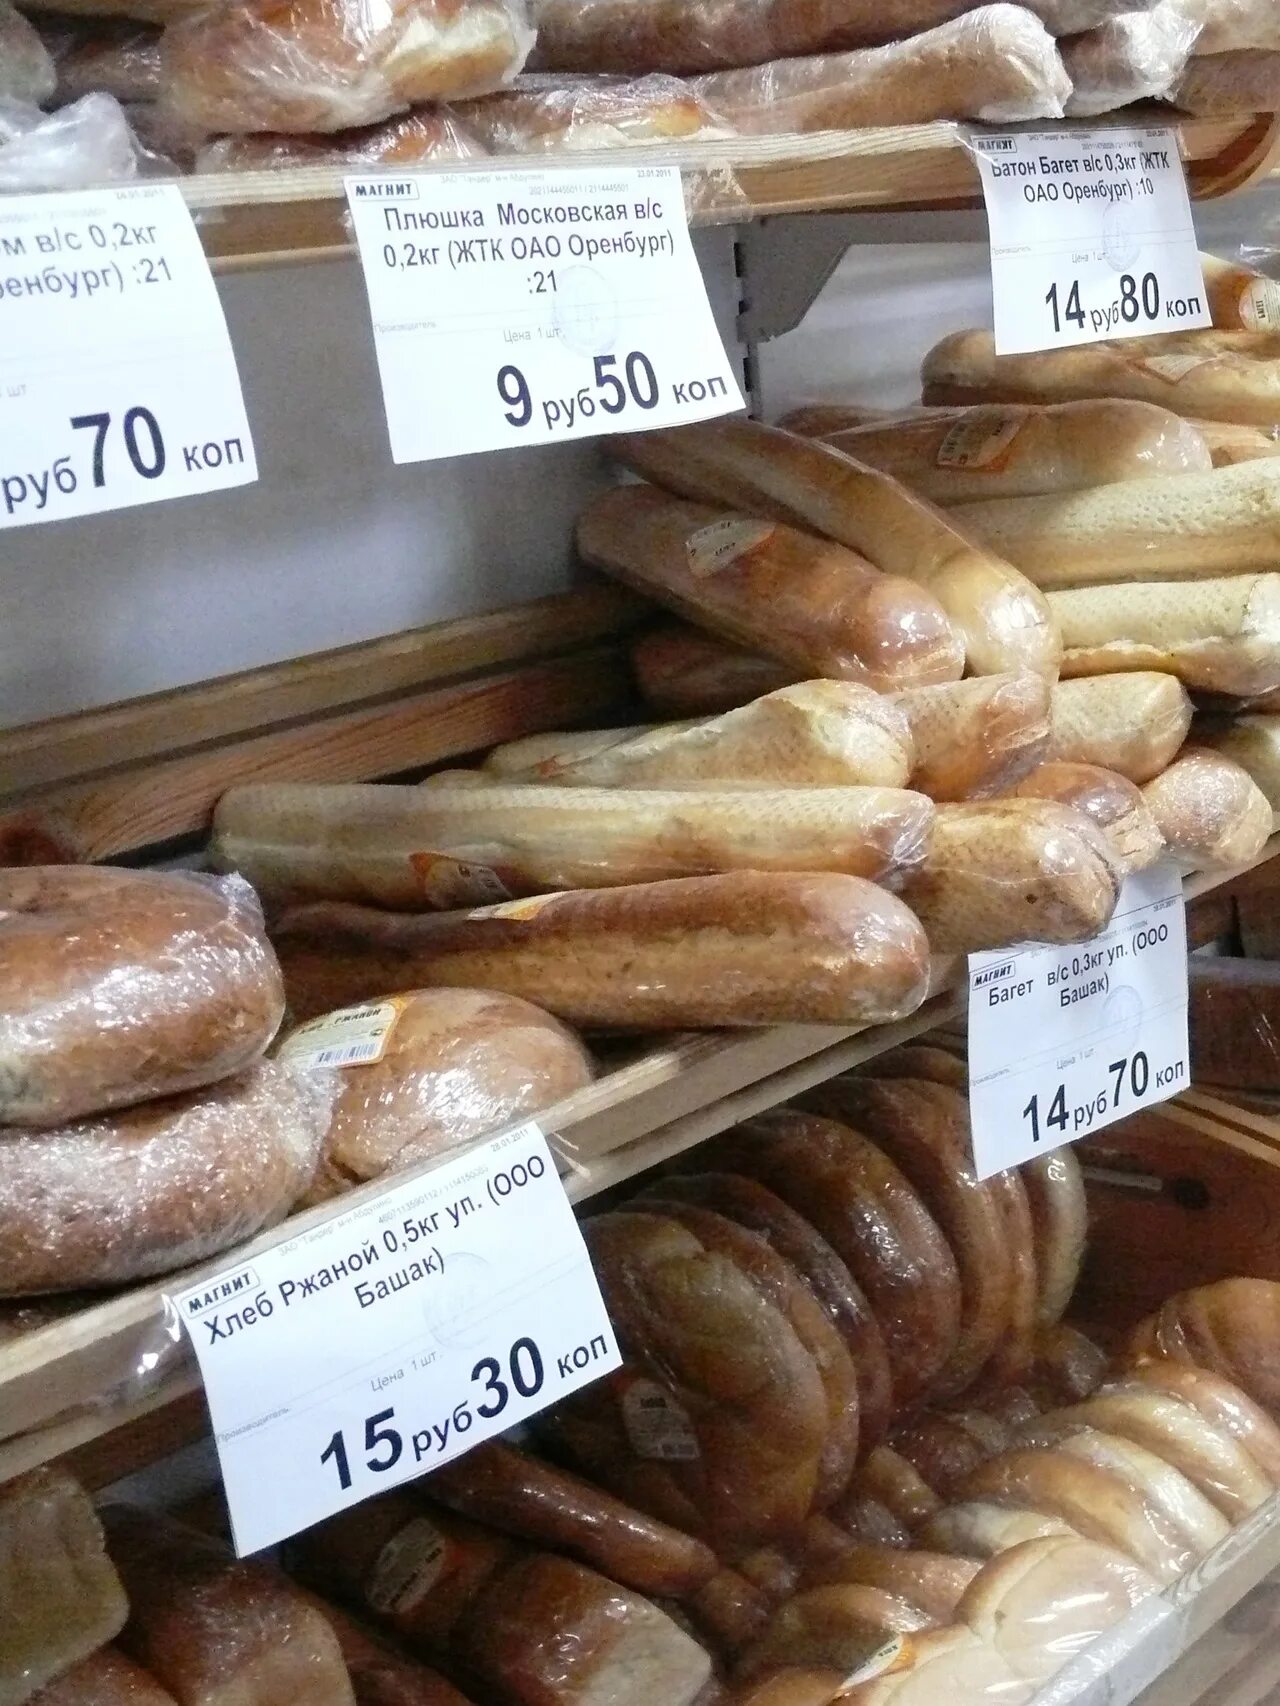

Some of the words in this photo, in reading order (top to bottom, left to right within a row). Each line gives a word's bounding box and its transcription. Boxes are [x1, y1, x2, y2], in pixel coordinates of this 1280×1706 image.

[991, 158, 1037, 178] Батон
[1038, 156, 1079, 175] Багет
[1084, 154, 1103, 173] в/с
[1104, 153, 1137, 175] 0,3кг
[1139, 151, 1170, 174] (ЖТК
[355, 182, 413, 198] МАГНИТ
[1023, 182, 1059, 203] ОАО
[1062, 178, 1133, 204] Оренбург)
[1135, 177, 1154, 196] :10
[383, 206, 485, 232] Плюшка
[496, 201, 628, 226] Московская
[634, 197, 664, 222] в/с
[0, 235, 26, 256] м
[35, 225, 83, 253] в/с
[87, 223, 157, 251] 0,2кг
[383, 243, 441, 271] 0,2кг
[447, 238, 505, 271] (ЖТК
[510, 234, 562, 260] ОАО
[567, 229, 676, 262] Оренбург)
[133, 255, 173, 285] :21
[526, 269, 558, 295] :21
[1045, 280, 1086, 333] 14
[1089, 300, 1120, 333] руб
[1119, 271, 1160, 324] 80
[1166, 294, 1202, 319] коп
[503, 328, 532, 345] Цена
[496, 364, 533, 428] 9
[542, 388, 597, 430] руб
[593, 350, 660, 415] 50
[672, 376, 728, 405] коп
[2, 455, 77, 515] руб
[69, 405, 167, 489] 70
[182, 437, 245, 473] коп
[974, 964, 1013, 987] МАГНИТ
[988, 979, 1035, 1007] Багет
[1047, 963, 1070, 987] в/с
[1072, 951, 1104, 977] 0,3кг
[1106, 943, 1129, 967] уп.
[1132, 923, 1169, 957] (ООО
[1060, 971, 1110, 1008] Башак)
[1022, 1084, 1071, 1144] 14
[1073, 1090, 1109, 1132] руб
[1108, 1050, 1150, 1108] 70
[1155, 1060, 1185, 1090] коп
[203, 1290, 274, 1346] Хлеб
[277, 1239, 382, 1307] Ржаной
[382, 1215, 441, 1255] 0,5кг
[446, 1196, 484, 1230] уп.
[486, 1154, 547, 1205] (ООО
[188, 1272, 251, 1314] МАГНИТ
[353, 1246, 446, 1310] Башак)
[370, 1368, 405, 1393] Цена
[411, 1359, 418, 1372] 1
[319, 1405, 403, 1491] 15
[411, 1400, 473, 1461] руб
[469, 1335, 545, 1420] 30
[556, 1333, 609, 1380] коп
